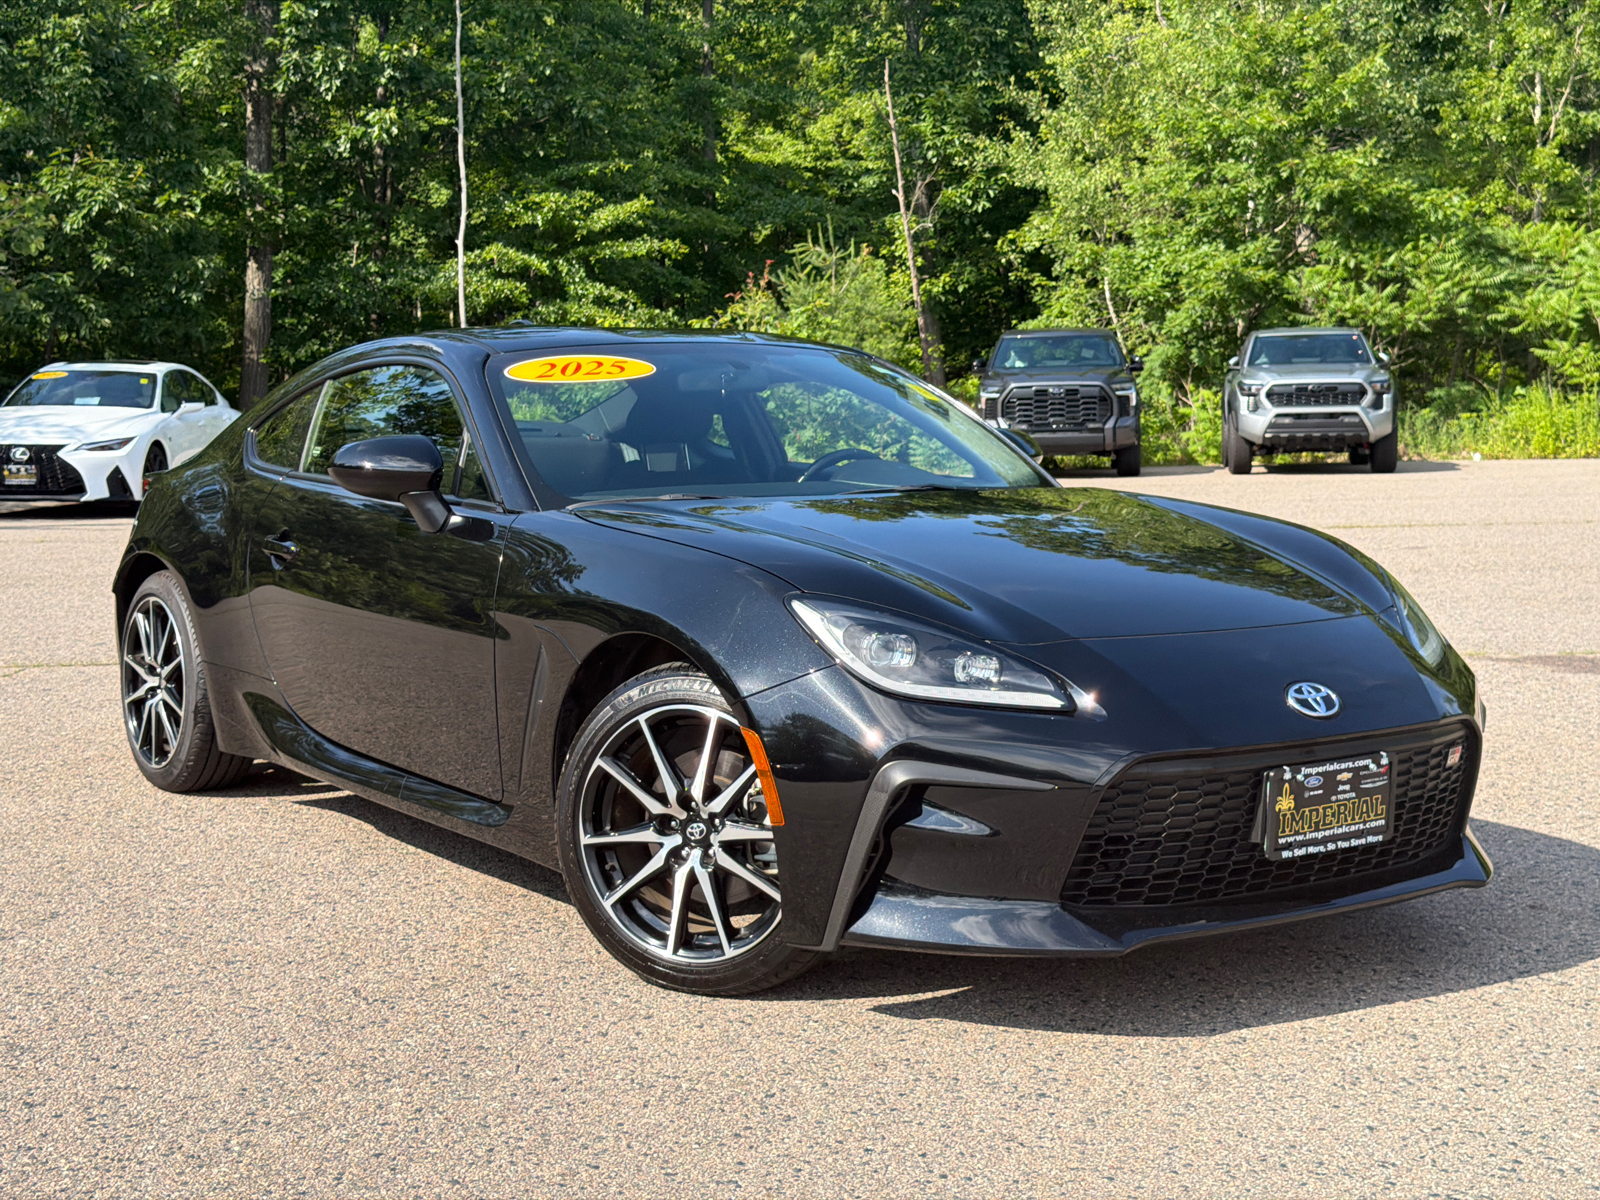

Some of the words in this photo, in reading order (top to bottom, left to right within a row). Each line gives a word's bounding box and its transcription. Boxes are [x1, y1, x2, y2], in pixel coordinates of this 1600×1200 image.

[535, 361, 628, 379] 2025
[1301, 759, 1372, 775] Imperialcars.com
[1337, 792, 1356, 800] TOYOTA
[1278, 795, 1386, 836] IMPERIAL
[1278, 819, 1385, 844] www.imperialcars.com
[1281, 849, 1293, 859] We
[1294, 847, 1306, 857] Sell
[1327, 842, 1336, 851] So
[1337, 840, 1350, 849] You
[1350, 838, 1366, 847] Save
[1366, 834, 1383, 843] More
